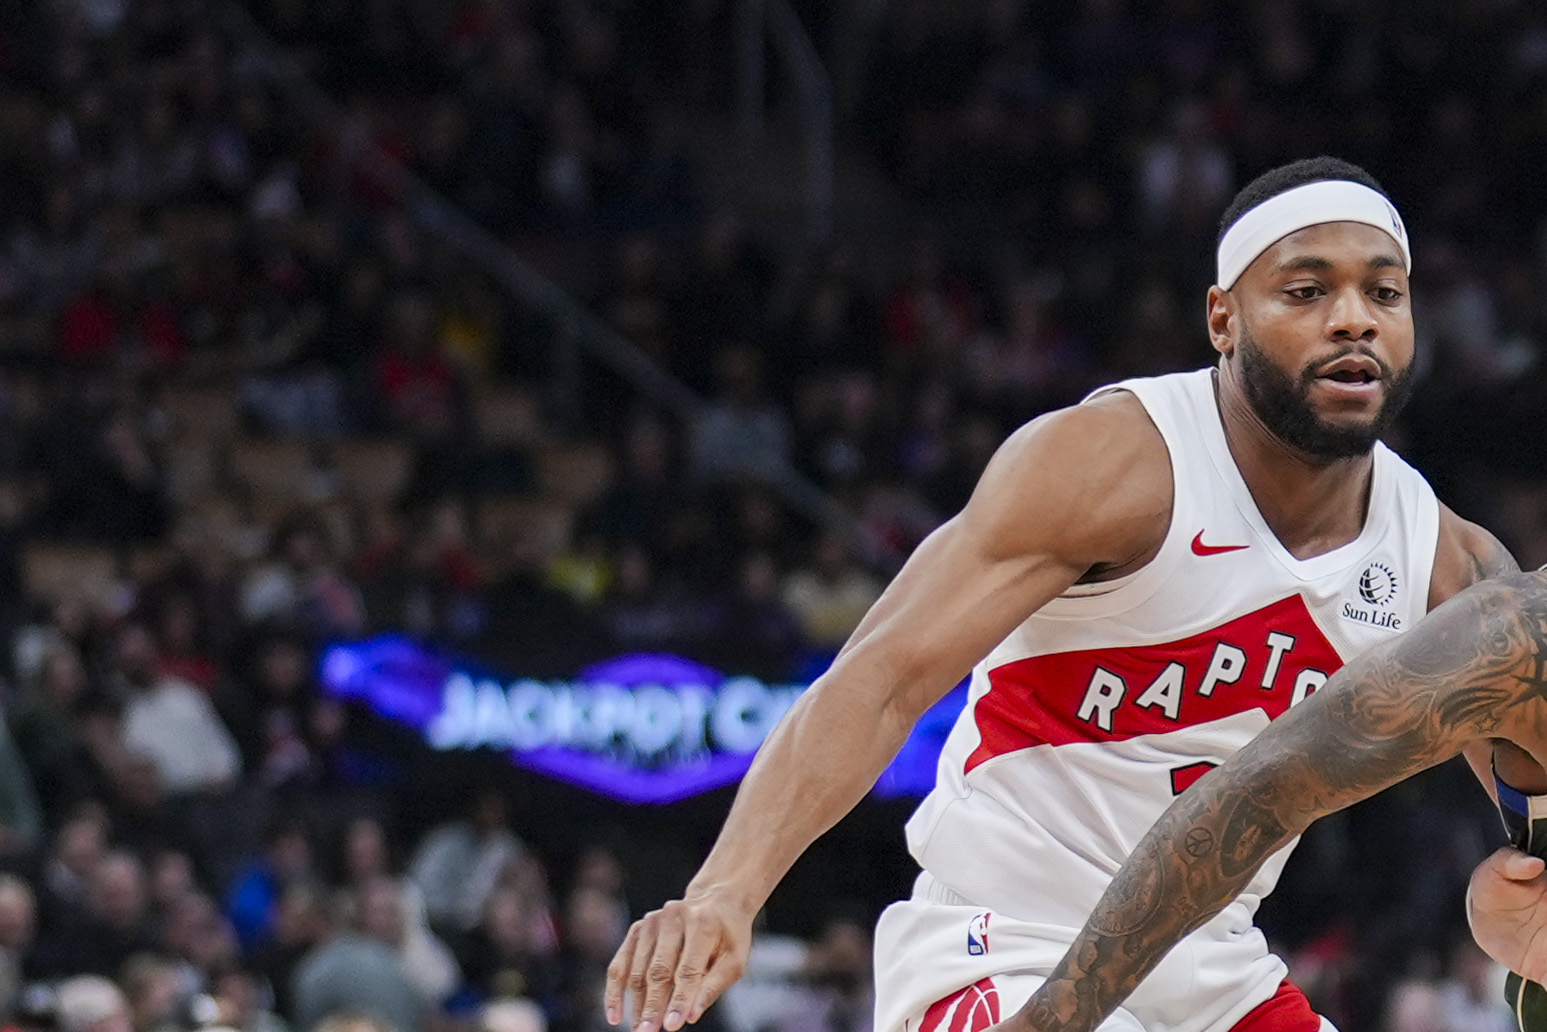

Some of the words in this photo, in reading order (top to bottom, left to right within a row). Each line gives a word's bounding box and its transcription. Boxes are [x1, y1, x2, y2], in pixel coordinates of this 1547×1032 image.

[1342, 602, 1368, 622] Sun
[1371, 610, 1402, 630] Life
[427, 673, 711, 752] JACKPOT
